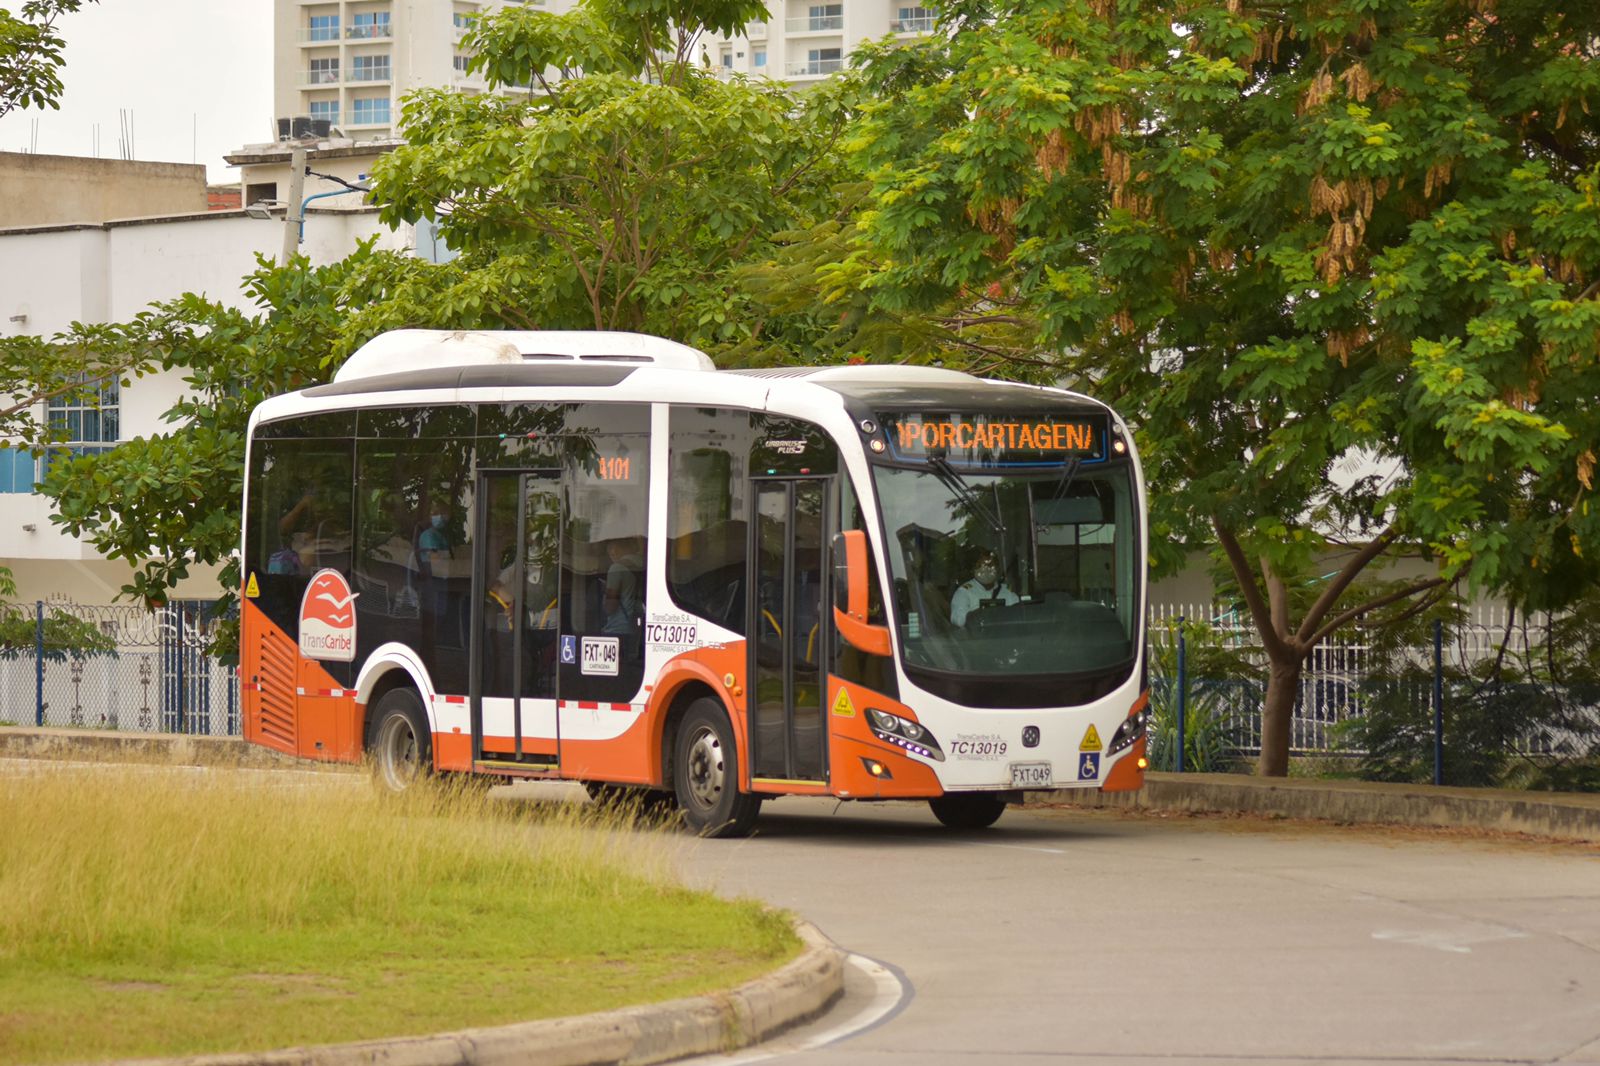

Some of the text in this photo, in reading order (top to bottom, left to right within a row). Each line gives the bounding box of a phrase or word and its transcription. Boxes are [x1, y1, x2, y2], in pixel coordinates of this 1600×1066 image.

[302, 633, 351, 649] TransCaribe
[647, 625, 696, 643] TC13019
[951, 742, 1007, 754] TC13019
[1013, 768, 1050, 782] FXT-049
